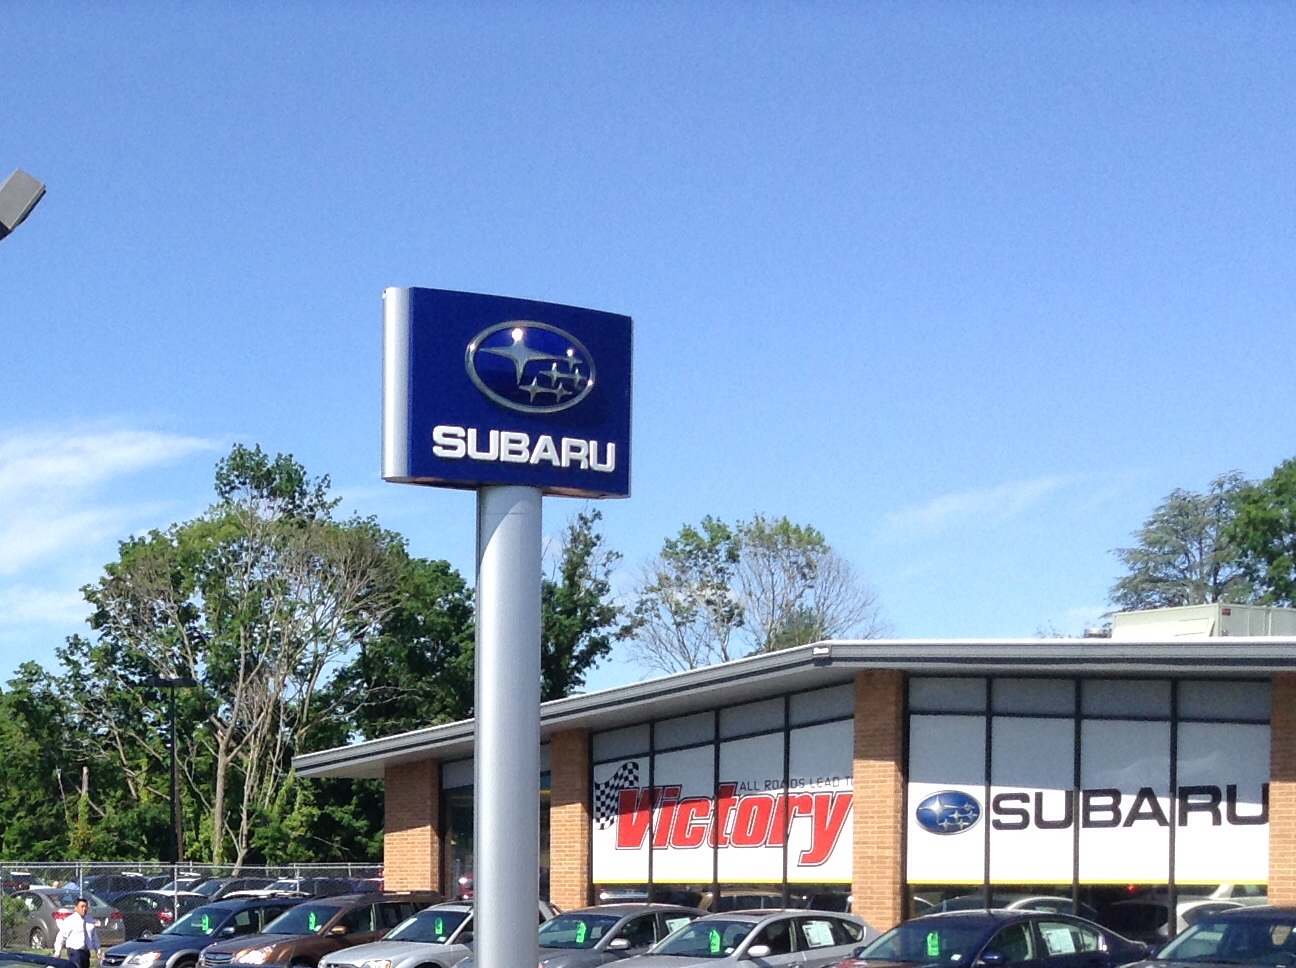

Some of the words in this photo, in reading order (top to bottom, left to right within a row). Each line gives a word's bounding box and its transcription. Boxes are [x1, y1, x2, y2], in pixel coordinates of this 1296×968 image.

[432, 425, 616, 472] SUBARU
[739, 781, 760, 792] ALL
[809, 776, 838, 789] LEAD
[844, 775, 853, 787] T
[991, 783, 1269, 831] SUBARU
[615, 781, 853, 867] Victory
